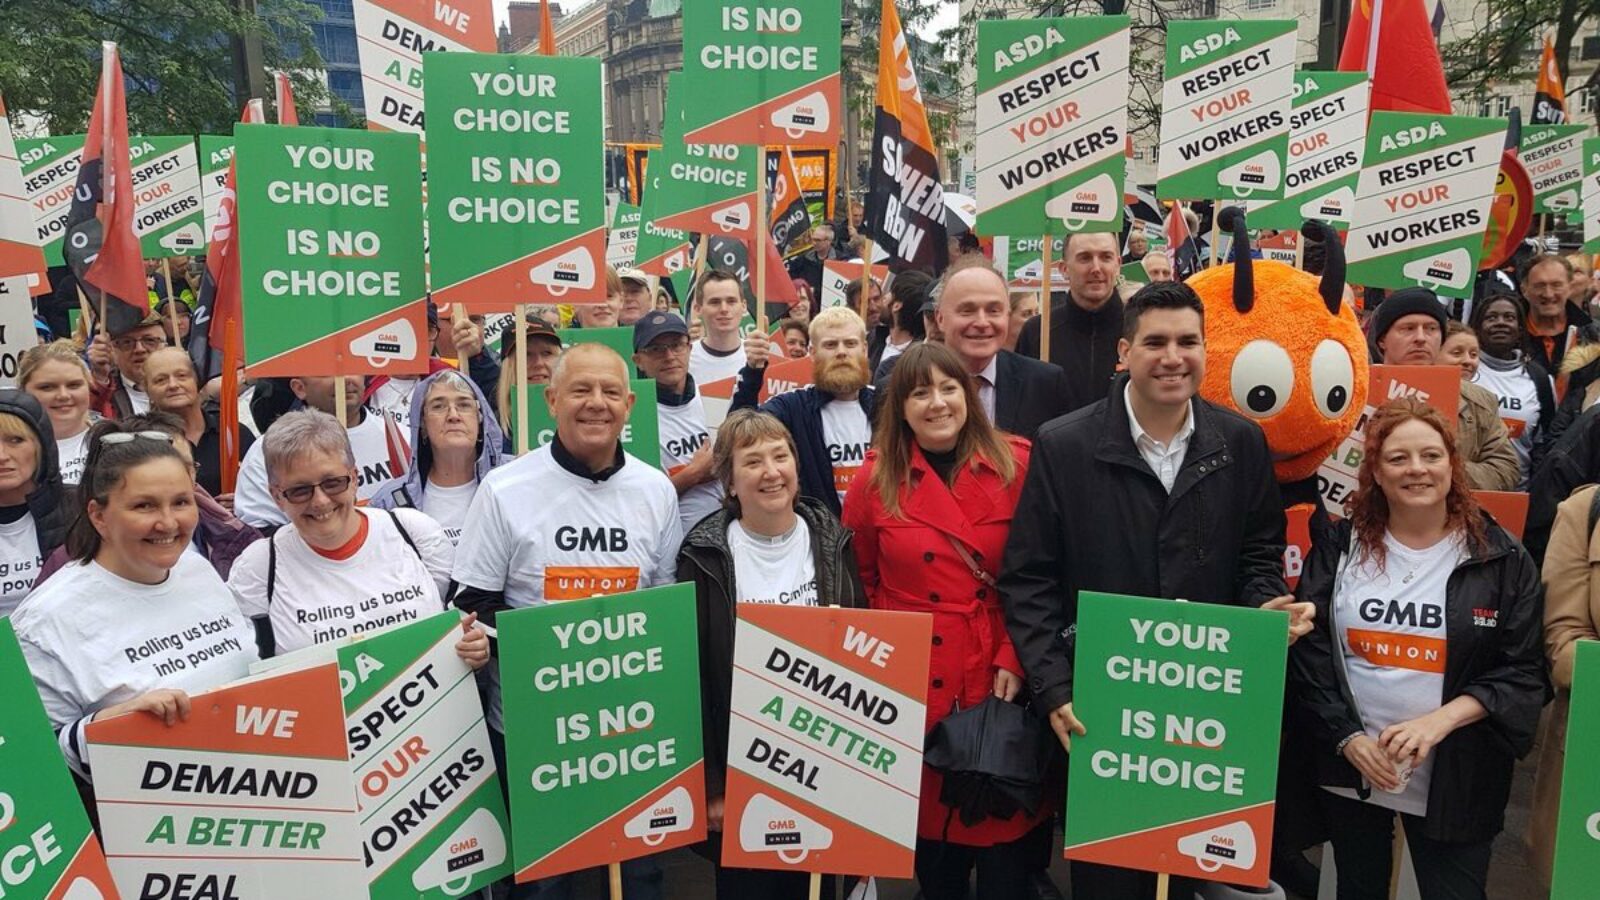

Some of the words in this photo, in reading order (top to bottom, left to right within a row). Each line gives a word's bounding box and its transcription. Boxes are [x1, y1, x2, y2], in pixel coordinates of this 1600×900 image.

[434, 0, 470, 34] WE
[721, 7, 749, 31] IS
[756, 7, 801, 32] NO
[700, 45, 818, 71] CHOICE
[994, 27, 1066, 72] ASDA
[1179, 27, 1242, 63] ASDA
[384, 60, 401, 81] A
[470, 72, 557, 98] YOUR
[998, 51, 1102, 113] RESPECT
[1181, 48, 1271, 96] RESPECT
[380, 95, 425, 130] DEA
[453, 108, 570, 134] CHOICE
[1191, 88, 1252, 123] YOUR
[1290, 97, 1346, 130] SPECT
[1009, 100, 1082, 145] YOUR
[1178, 110, 1284, 161] WORKERS
[1379, 121, 1447, 153] ASDA
[1522, 128, 1557, 146] ASDA
[19, 142, 57, 168] SDA
[129, 141, 156, 160] DA
[285, 144, 375, 171] YOUR
[708, 143, 740, 160] NO
[998, 125, 1119, 191] WORKERS
[1290, 132, 1329, 157] OUR
[1523, 138, 1574, 163] RESPECT
[471, 156, 502, 183] IS
[510, 157, 561, 184] NO
[670, 163, 748, 188] CHOICE
[1286, 151, 1358, 188] ORKERS
[1378, 146, 1477, 186] RESPECT
[1528, 157, 1562, 176] YOUR
[1534, 169, 1580, 191] ORKERS
[267, 181, 389, 207] CHOICE
[1075, 192, 1098, 202] GMB
[1384, 184, 1449, 213] YOUR
[448, 197, 580, 224] CHOICE
[287, 229, 320, 255] IS
[328, 230, 381, 257] NO
[1367, 208, 1481, 249] WORKERS
[263, 271, 400, 297] CHOICE
[1496, 395, 1522, 411] MB
[554, 525, 629, 551] GMB
[558, 577, 628, 590] UNION
[296, 605, 355, 624] Rolling
[360, 597, 379, 612] us
[382, 584, 424, 605] back
[1359, 598, 1442, 629] GMB
[125, 633, 184, 663] Rolling
[182, 627, 201, 641] us
[199, 615, 234, 635] back
[313, 626, 347, 644] into
[551, 611, 647, 649] YOUR
[1129, 618, 1231, 653] YOUR
[152, 657, 186, 677] into
[186, 638, 242, 668] poverty
[841, 625, 895, 669] WE
[1361, 641, 1438, 661] UNION
[533, 647, 663, 692] CHOICE
[1106, 655, 1242, 694] CHOICE
[765, 647, 899, 726] DEMAND
[235, 705, 299, 738] WE
[348, 663, 441, 757] SPECT
[556, 712, 591, 744] IS
[599, 701, 656, 737] NO
[759, 695, 783, 722] A
[788, 707, 898, 775] BETTER
[1121, 708, 1156, 739] IS
[1164, 714, 1227, 748] NO
[140, 760, 318, 799] DEMAND
[356, 735, 431, 811] OUR
[530, 738, 677, 793] CHOICE
[746, 737, 820, 791] DEAL
[1091, 749, 1245, 796] CHOICE
[653, 807, 674, 817] GMB
[768, 819, 797, 831] GMB
[145, 815, 176, 844] A
[186, 816, 326, 849] BETTER
[450, 837, 478, 854] GMB
[1211, 834, 1234, 847] GMB
[139, 872, 240, 900] DEAL
